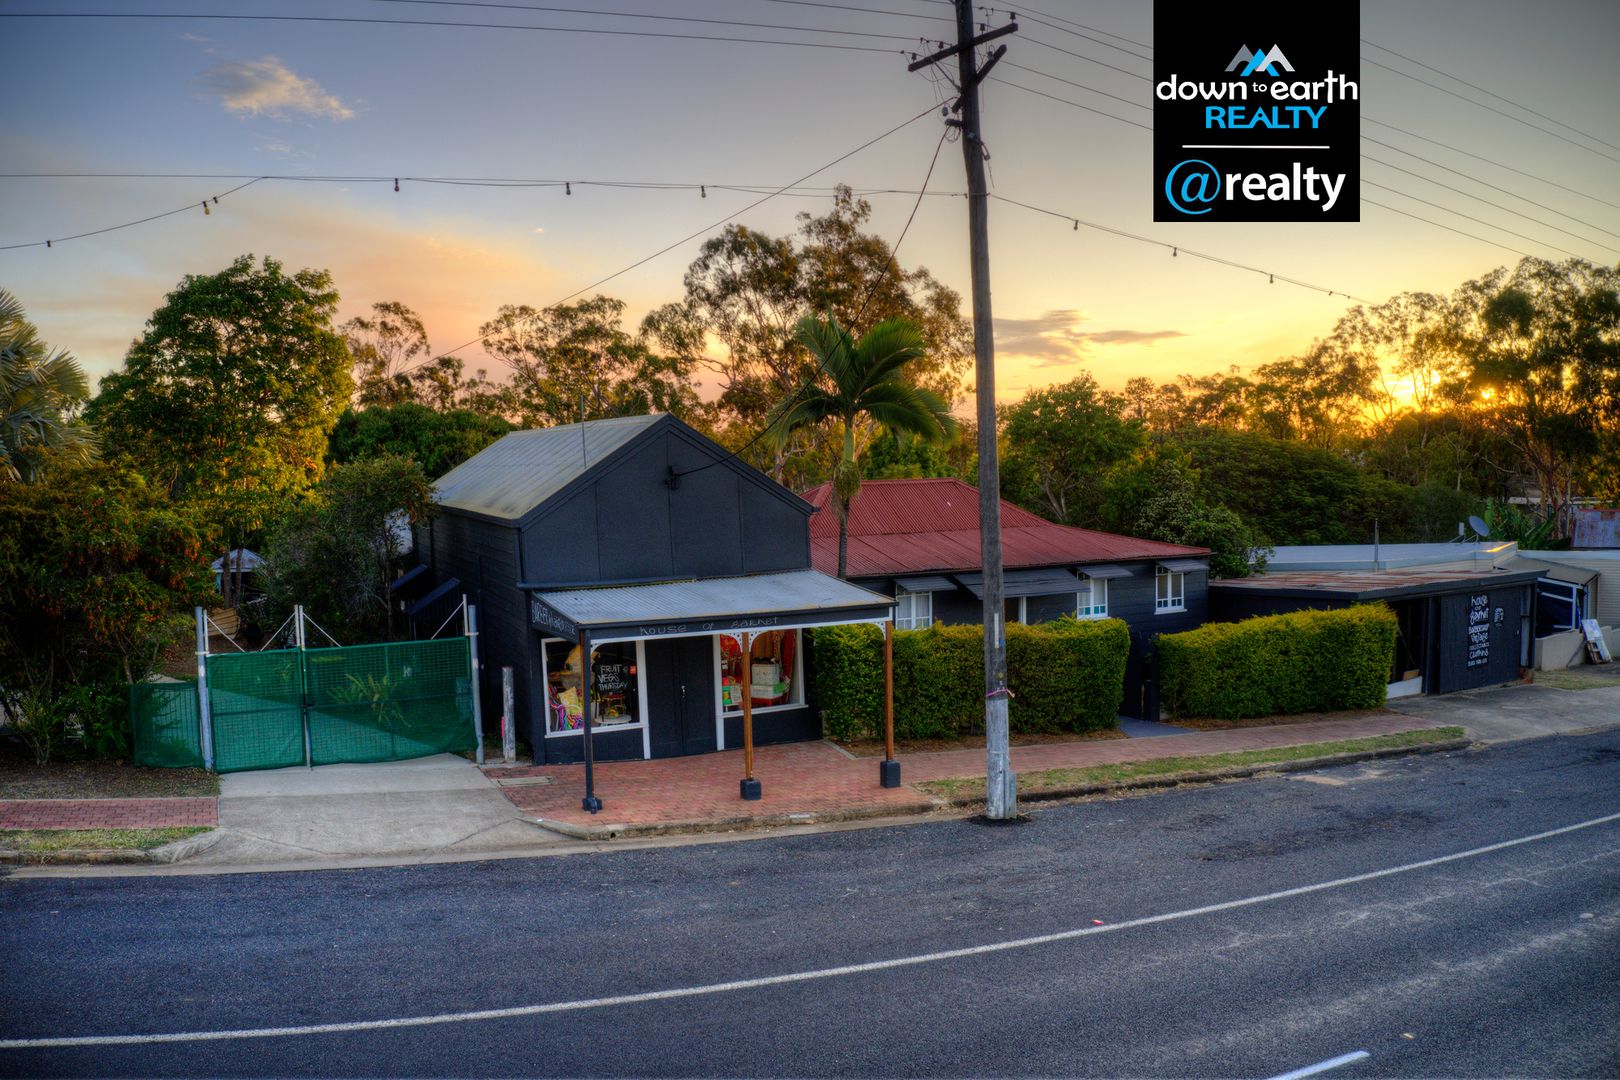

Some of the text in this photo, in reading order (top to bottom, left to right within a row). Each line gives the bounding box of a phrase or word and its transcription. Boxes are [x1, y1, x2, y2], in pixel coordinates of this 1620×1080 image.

[600, 664, 622, 673] FRUIT
[598, 672, 620, 684] VEGS
[598, 681, 628, 690] THURSDAY
